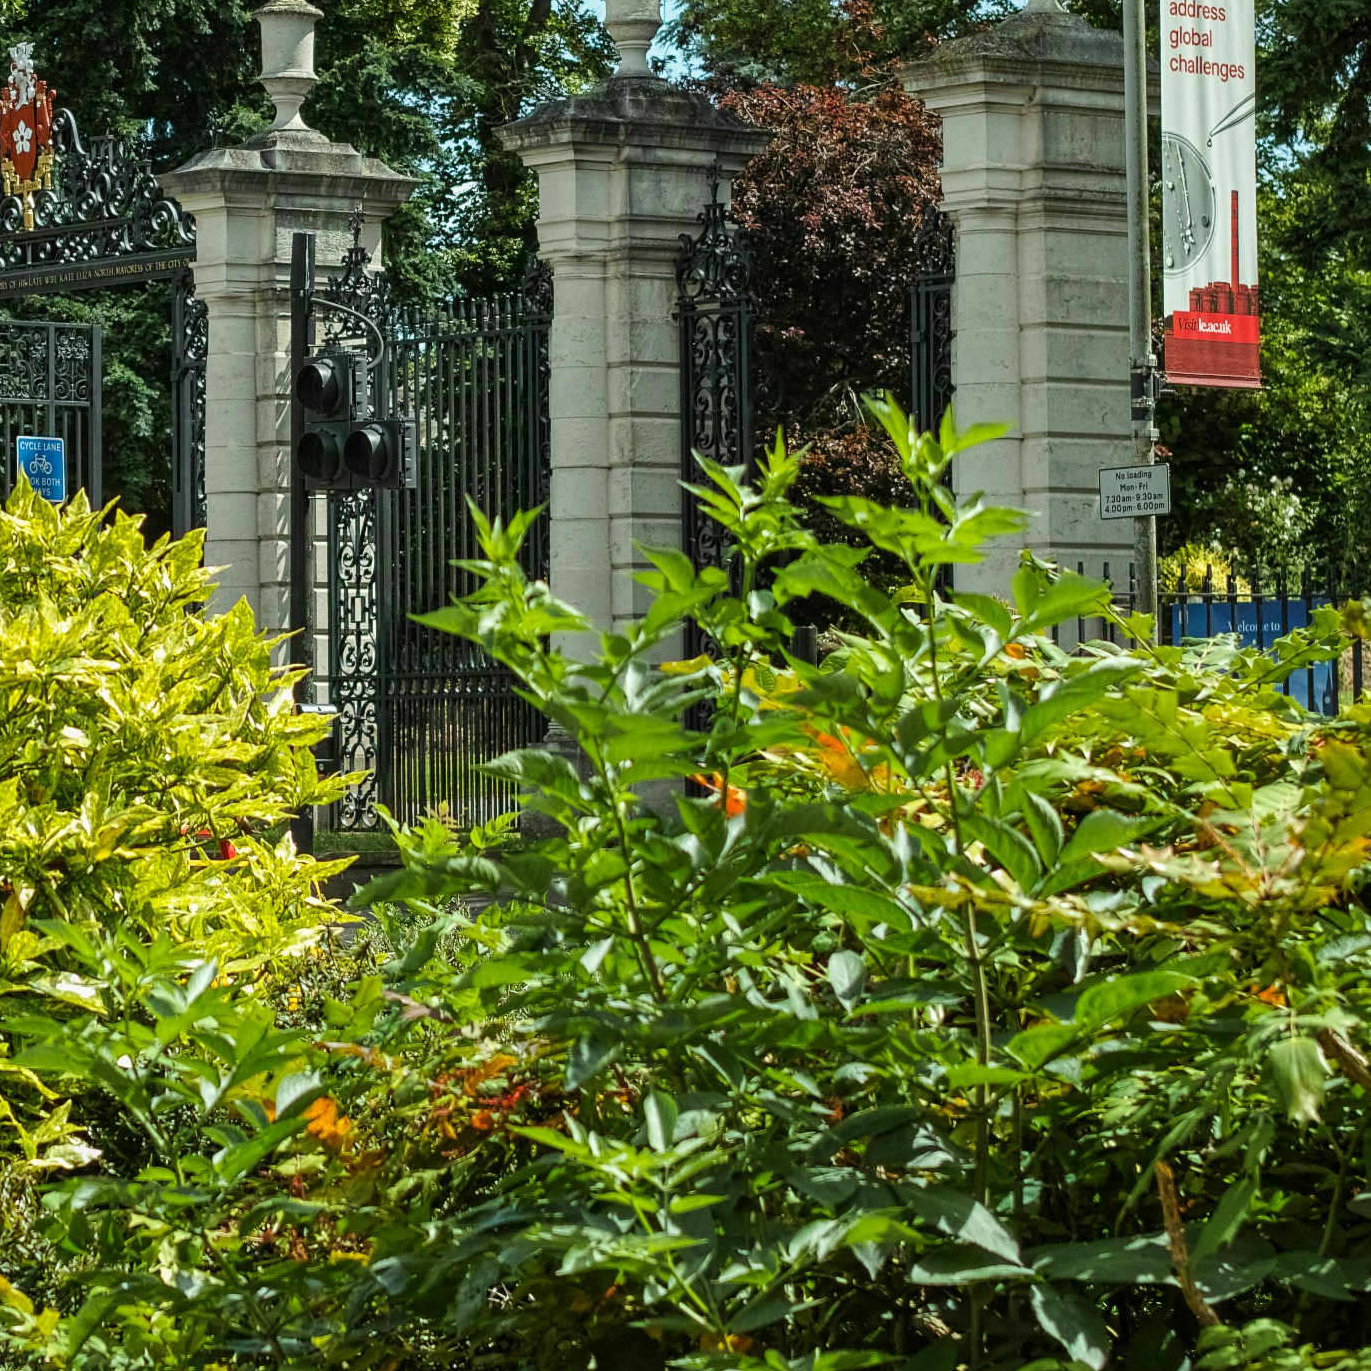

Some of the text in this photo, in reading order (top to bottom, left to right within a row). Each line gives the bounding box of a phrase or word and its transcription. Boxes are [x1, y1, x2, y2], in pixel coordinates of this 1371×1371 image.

[1169, 0, 1226, 21] address
[1169, 26, 1213, 49] global
[1169, 56, 1245, 82] challenges
[9, 280, 17, 289] OF
[28, 277, 42, 287] LATE
[44, 275, 58, 285] WIFE
[59, 272, 74, 283] KATE
[145, 262, 153, 272] OF
[155, 261, 166, 271] THE
[167, 259, 181, 269] CITY
[1177, 317, 1232, 335] Visit le.ac.uk
[19, 441, 60, 451] CYCLE LANE
[42, 477, 60, 486] BOTH
[1115, 471, 1152, 480] No loading
[1270, 621, 1280, 631] to
